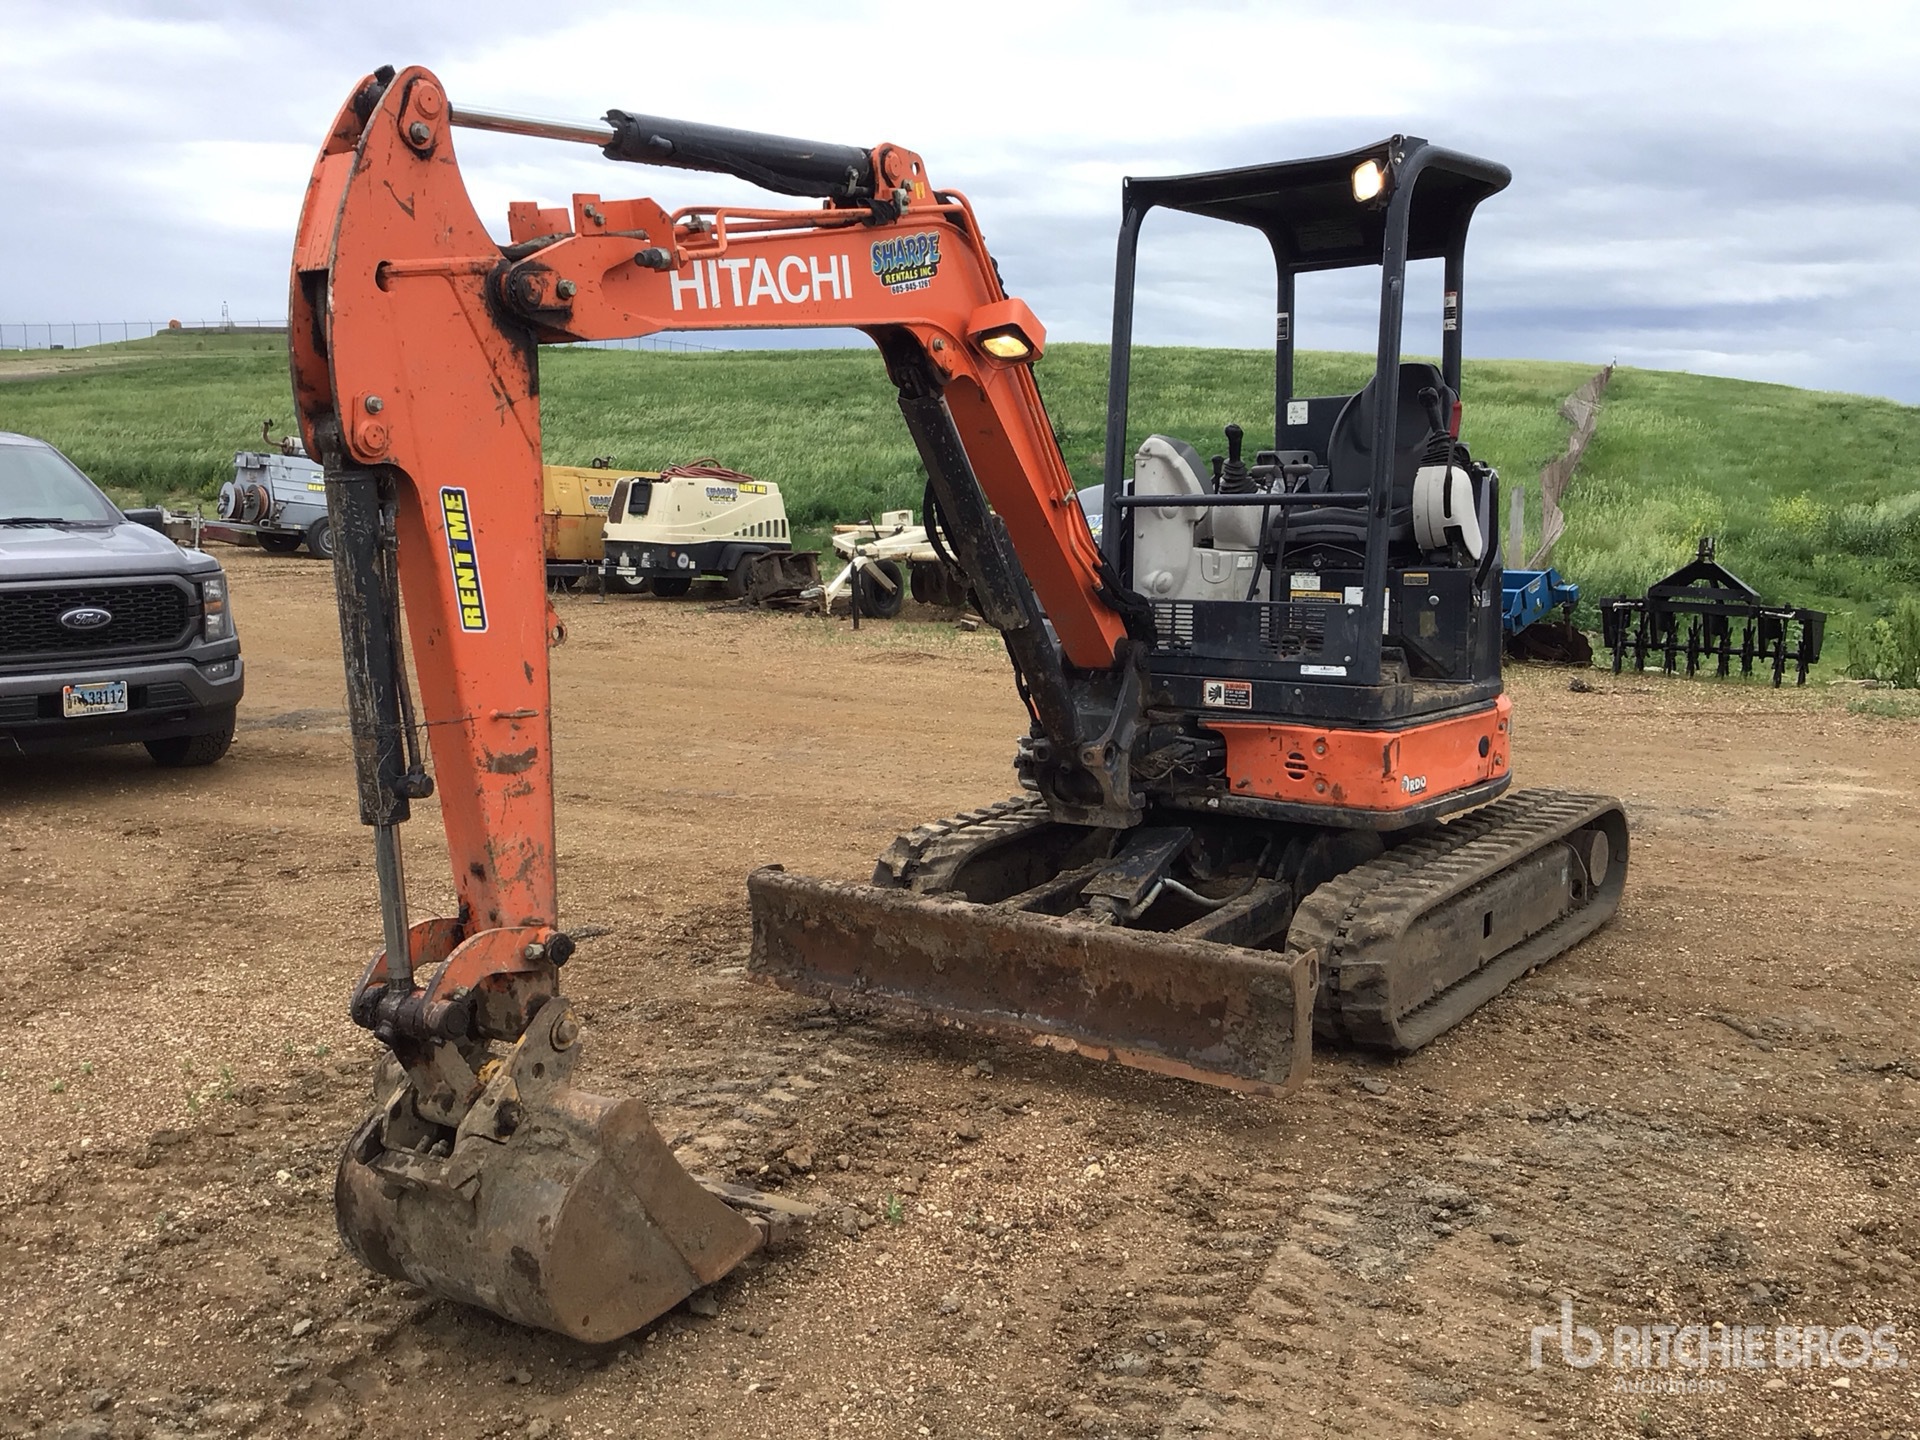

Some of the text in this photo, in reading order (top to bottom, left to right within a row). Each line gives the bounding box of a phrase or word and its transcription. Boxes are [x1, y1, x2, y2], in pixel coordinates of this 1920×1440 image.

[871, 231, 941, 275] SHARPE
[669, 254, 854, 311] HITACHI
[884, 266, 935, 285] RENTALS INC.
[739, 483, 755, 493] RENT
[443, 493, 483, 628] RENT ME
[74, 612, 101, 625] Ford
